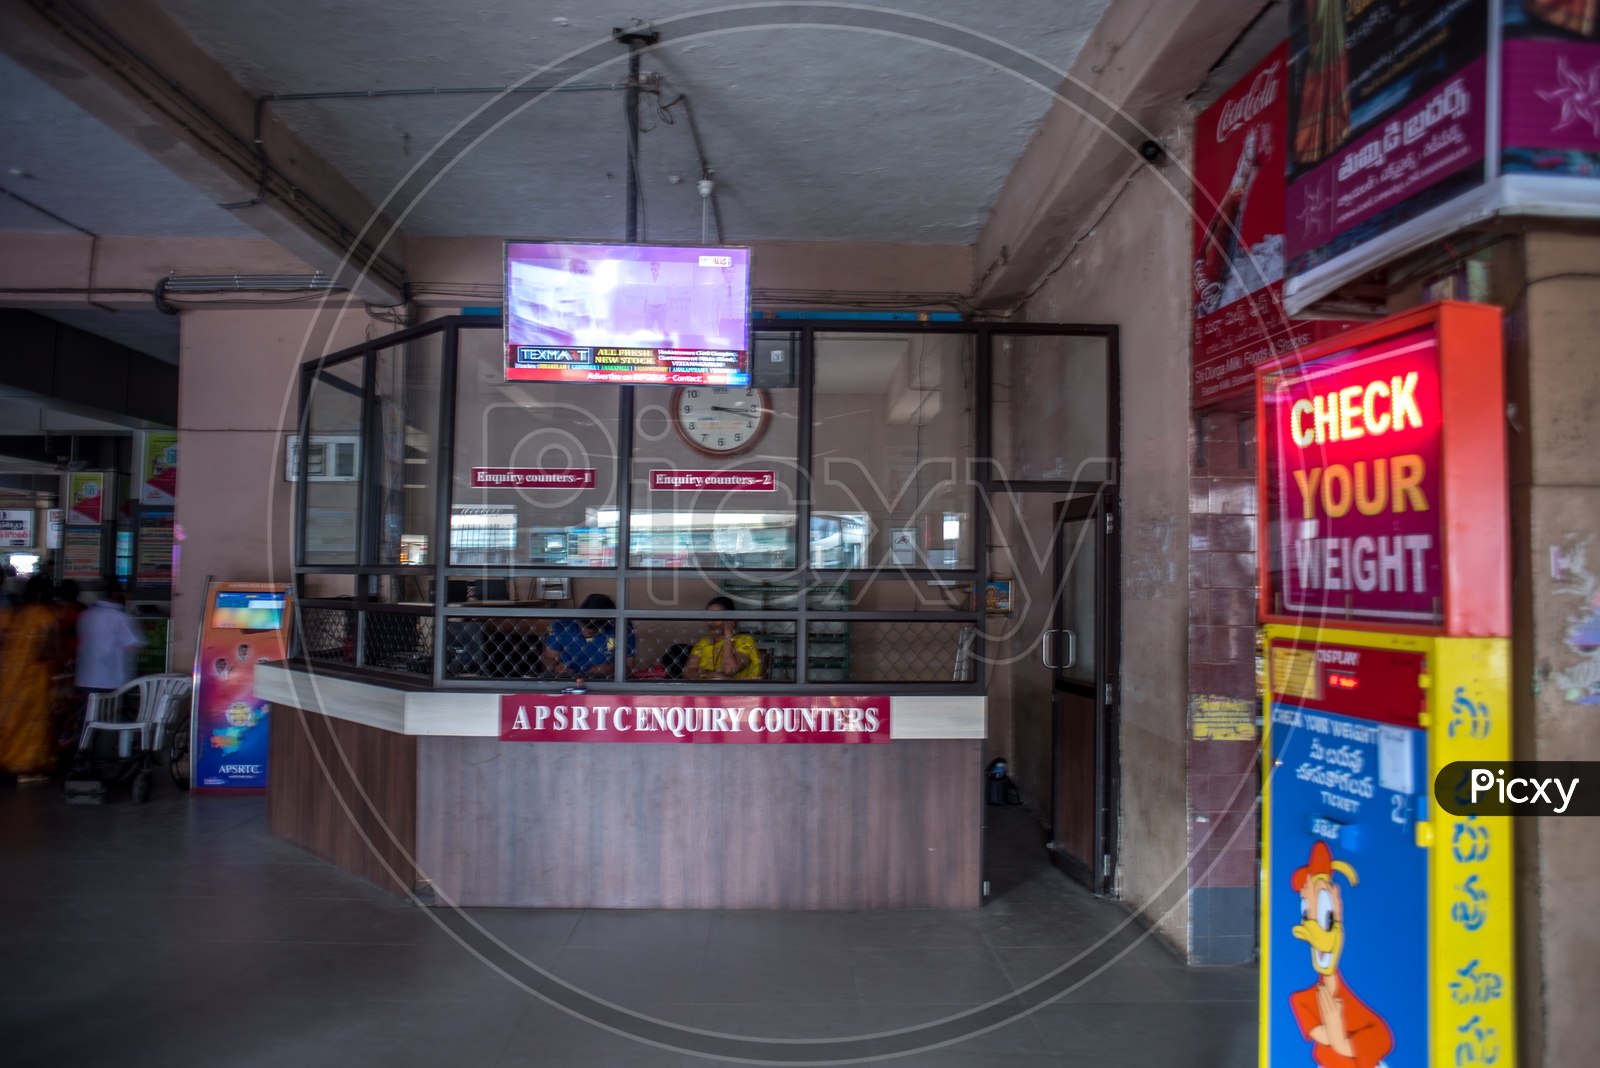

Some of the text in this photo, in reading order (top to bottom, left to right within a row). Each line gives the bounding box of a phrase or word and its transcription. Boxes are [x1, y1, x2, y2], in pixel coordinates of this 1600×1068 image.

[521, 349, 588, 361] TEXMART
[619, 349, 652, 357] FRESH
[1244, 350, 1267, 365] Foods
[595, 356, 655, 365] NEW STOCK
[686, 389, 699, 399] 10
[683, 405, 692, 413] 9
[750, 404, 758, 413] 3
[1290, 371, 1422, 449] CHECK
[688, 422, 695, 430] 8
[745, 421, 754, 429] 4
[700, 433, 709, 442] 7
[717, 438, 726, 446] 6
[734, 433, 742, 441] 5
[477, 471, 524, 484] Enquiry
[655, 474, 703, 487] Enquiry
[1293, 454, 1430, 519] YOUR
[1295, 533, 1433, 593] WEIGHT
[1316, 649, 1360, 665] DISPLAY
[634, 706, 752, 738] ENQUIRY
[748, 706, 881, 733] COUNTERS
[1272, 708, 1304, 728] CHECK
[1304, 714, 1331, 735] YOUR
[1330, 718, 1378, 745] WEIGHT
[218, 764, 261, 774] APSRTC
[1320, 790, 1361, 814] TICKET
